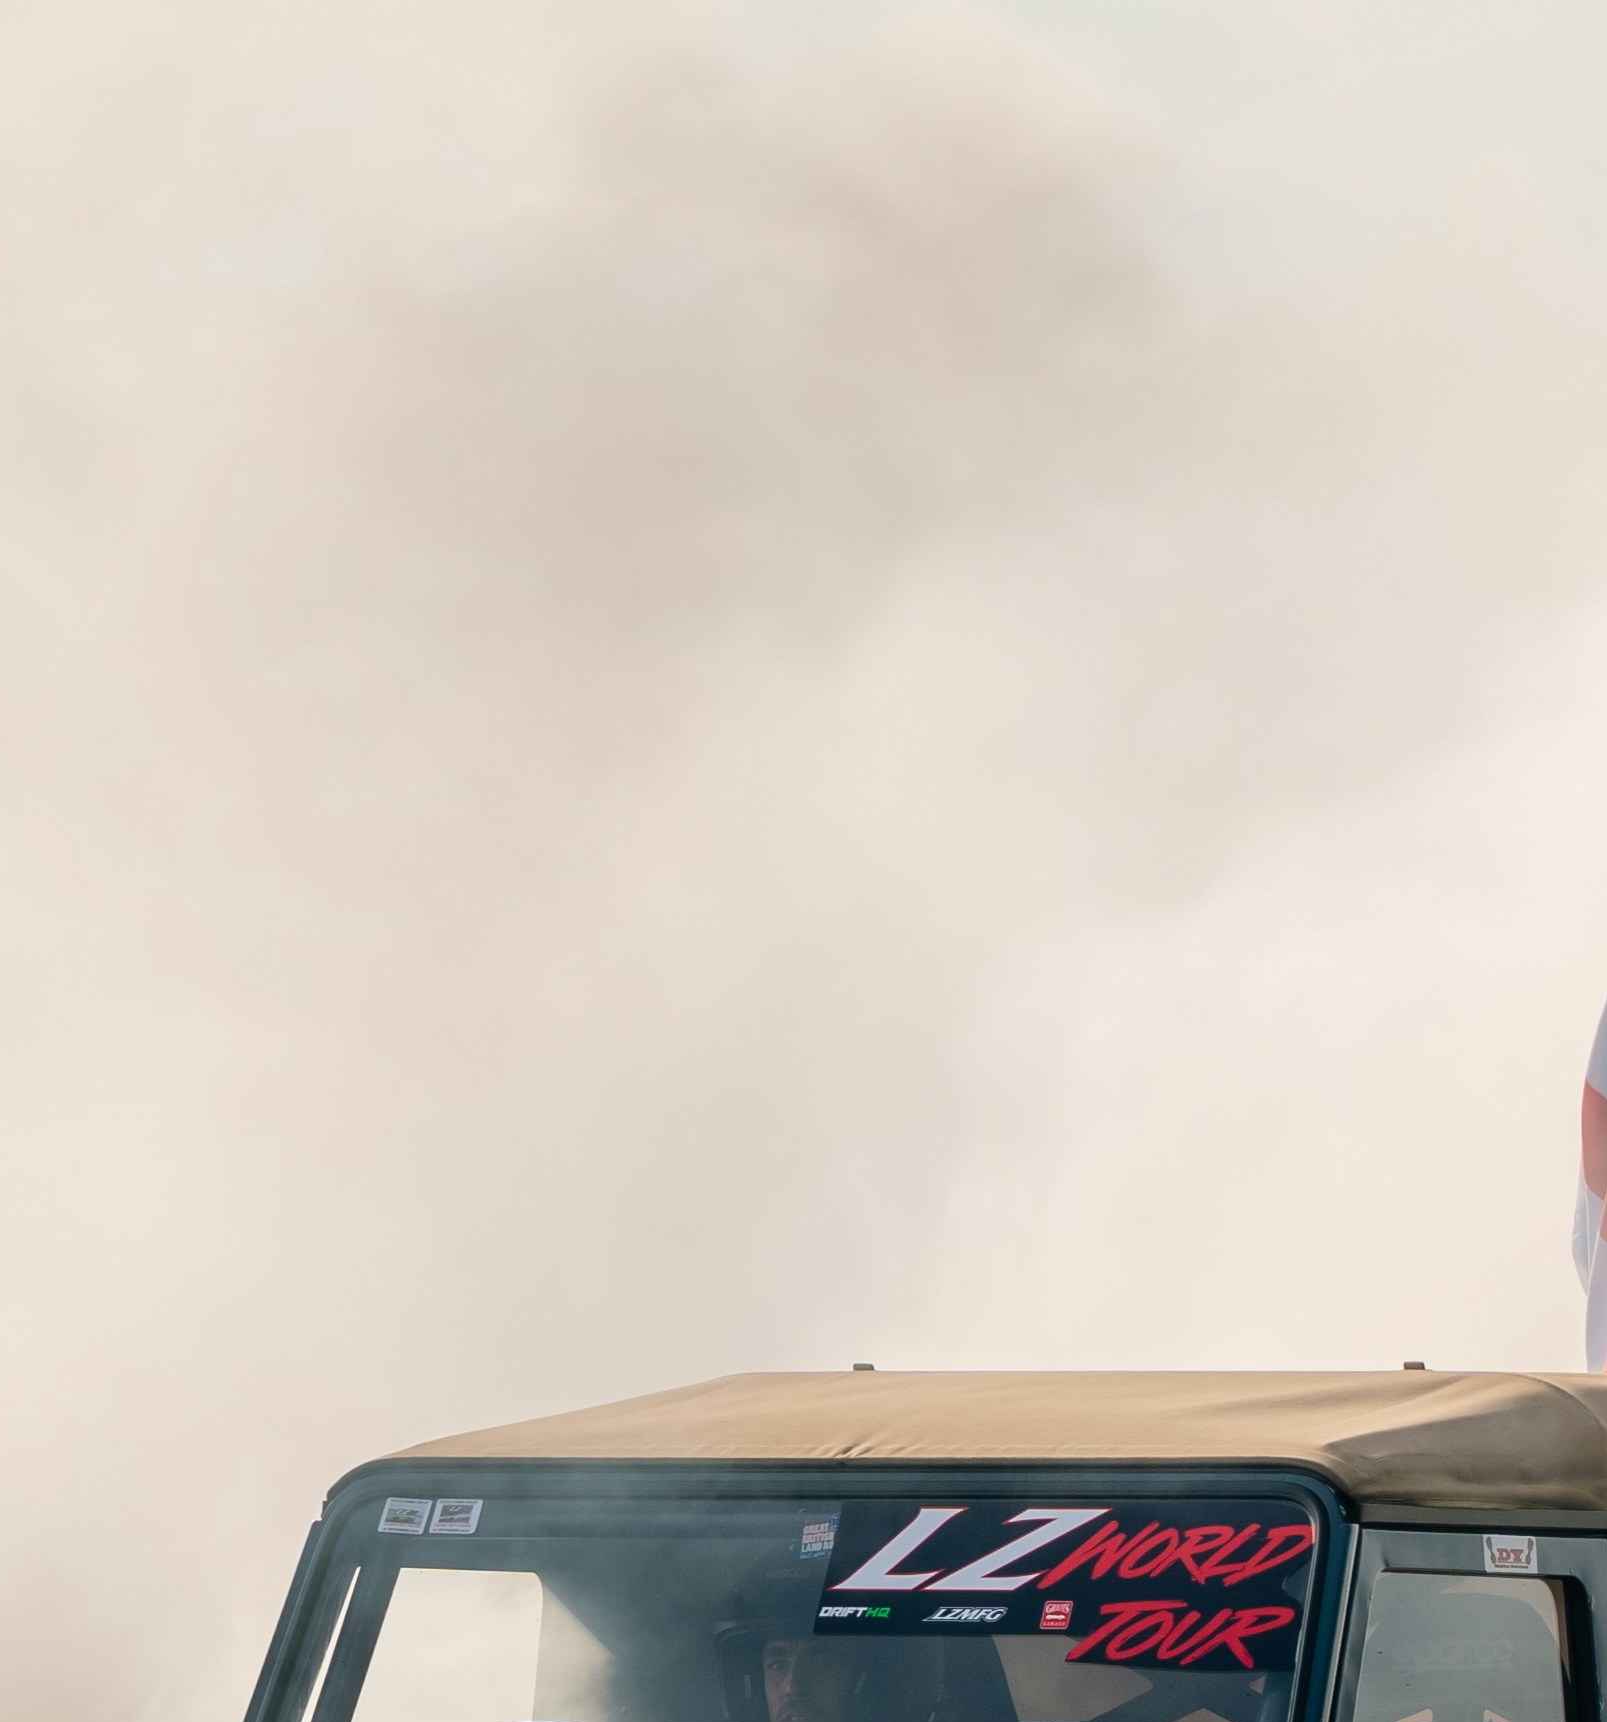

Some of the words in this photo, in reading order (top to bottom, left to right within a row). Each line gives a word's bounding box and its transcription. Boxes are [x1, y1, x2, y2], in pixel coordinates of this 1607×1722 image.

[826, 1506, 1112, 1591] LZ
[1037, 1519, 1316, 1590] WORLD
[1496, 1547, 1524, 1562] DY
[927, 1606, 1005, 1622] LZMFG
[1065, 1599, 1295, 1668] TOUR
